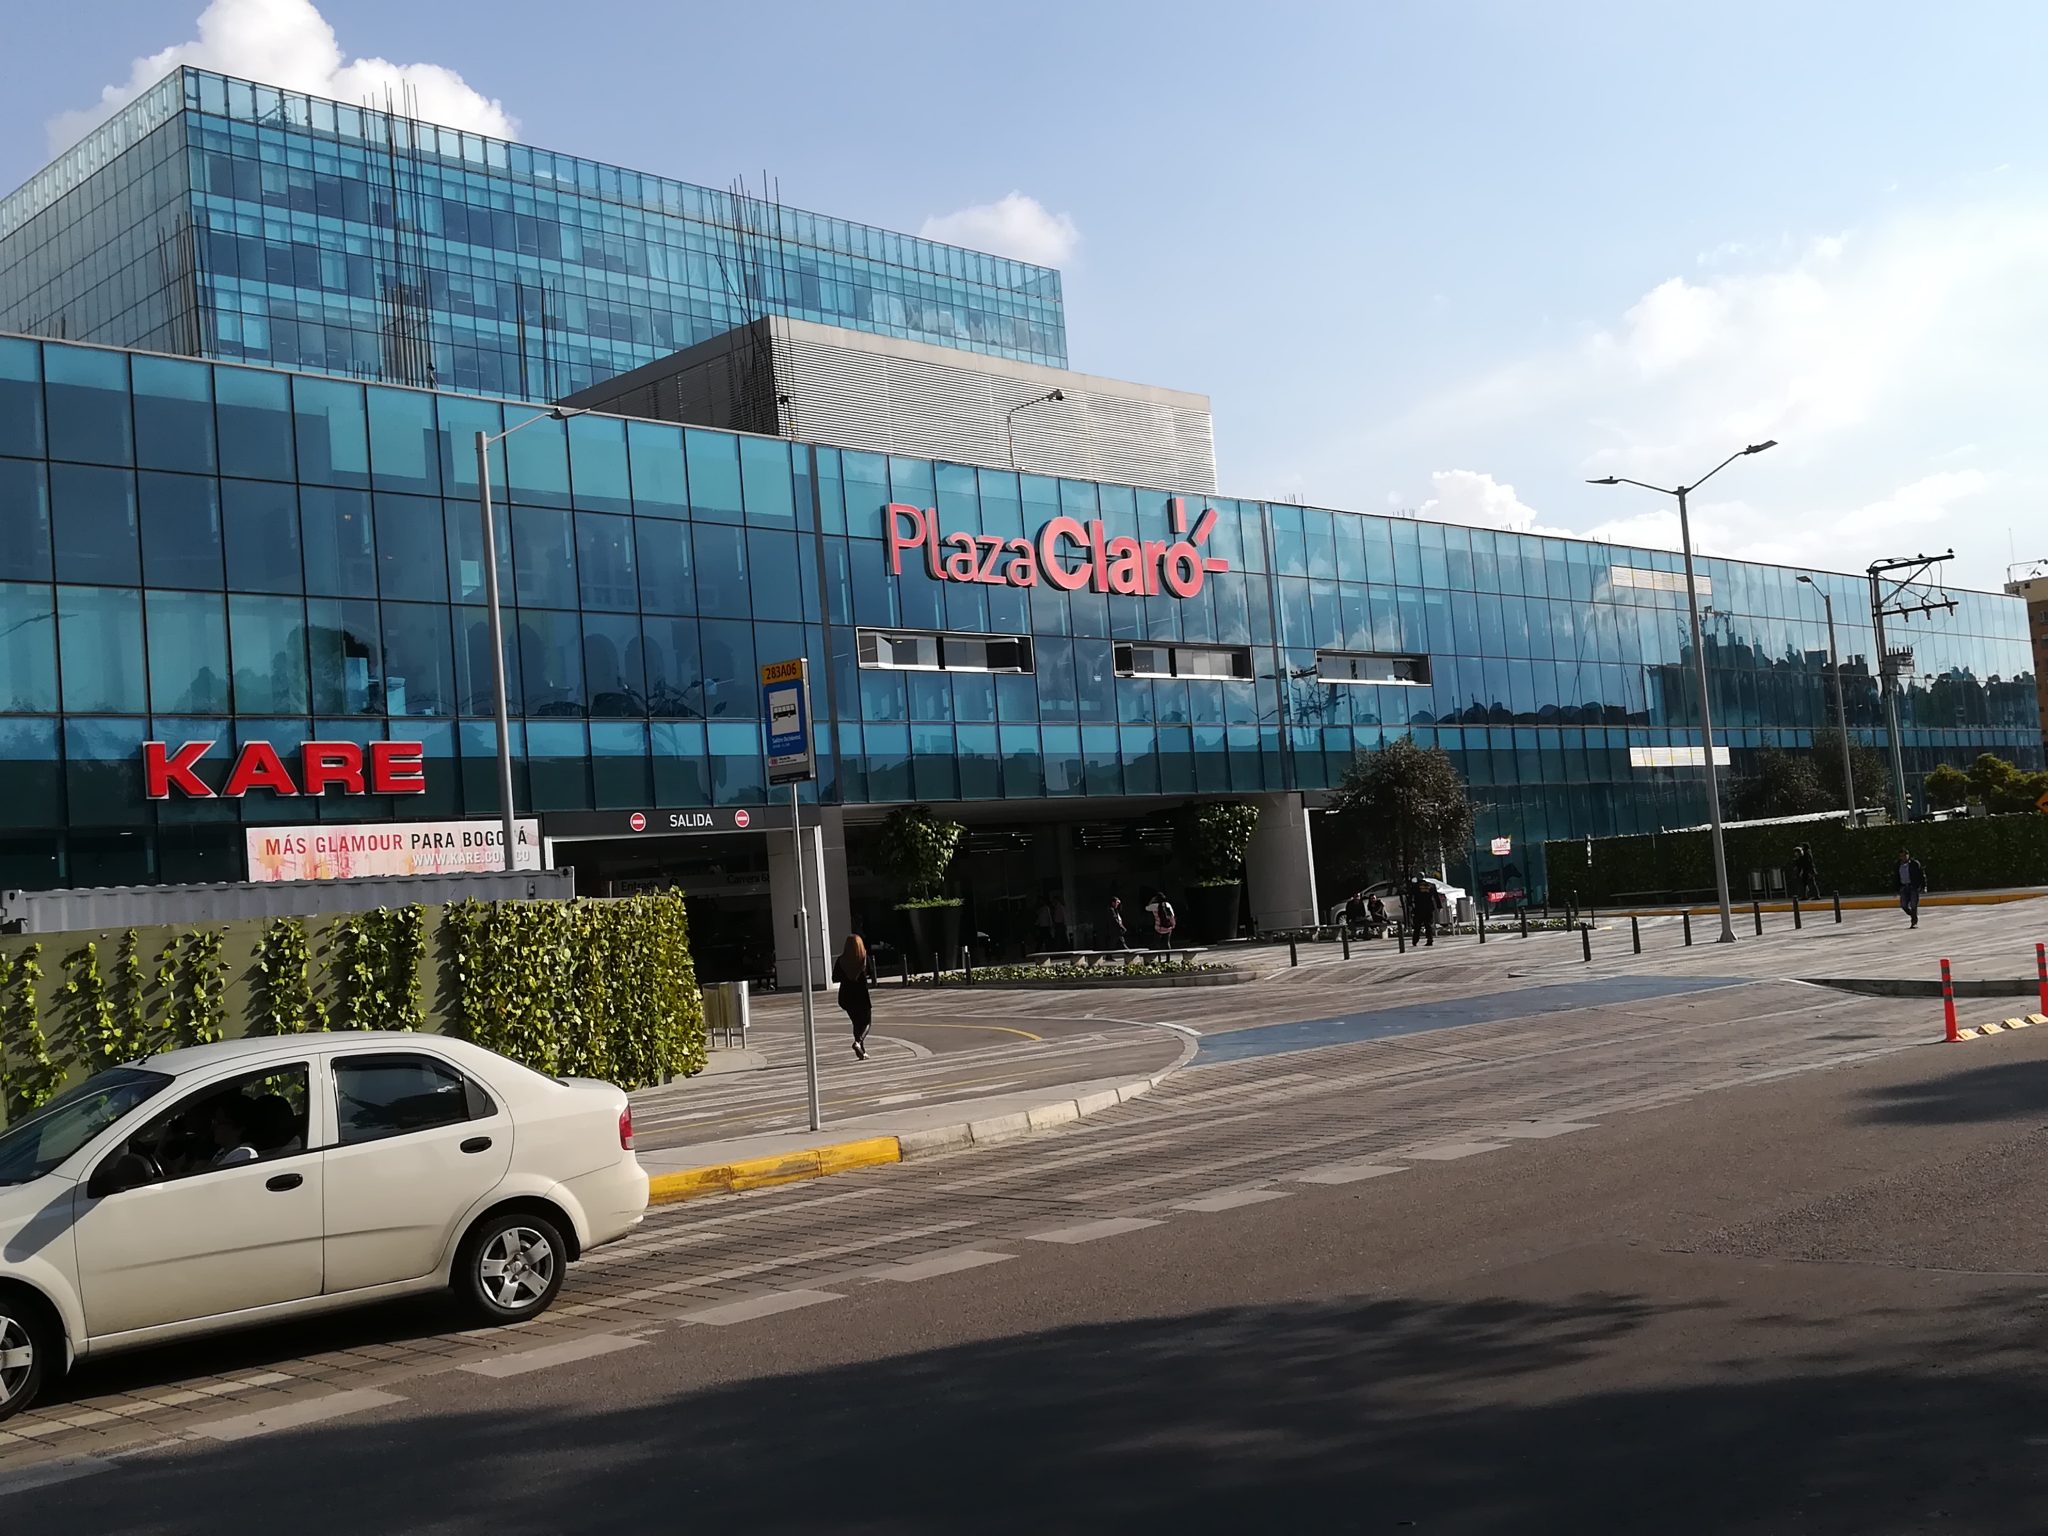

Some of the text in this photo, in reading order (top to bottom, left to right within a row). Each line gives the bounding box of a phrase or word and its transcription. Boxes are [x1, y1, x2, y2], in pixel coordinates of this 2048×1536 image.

[766, 662, 797, 680] 283A06
[142, 740, 426, 799] KARE
[669, 813, 714, 828] SALIDA
[265, 826, 527, 856] MÁS GLAMOUR PARA BOGOÁ
[413, 850, 530, 867] WWW.KARE.COCO
